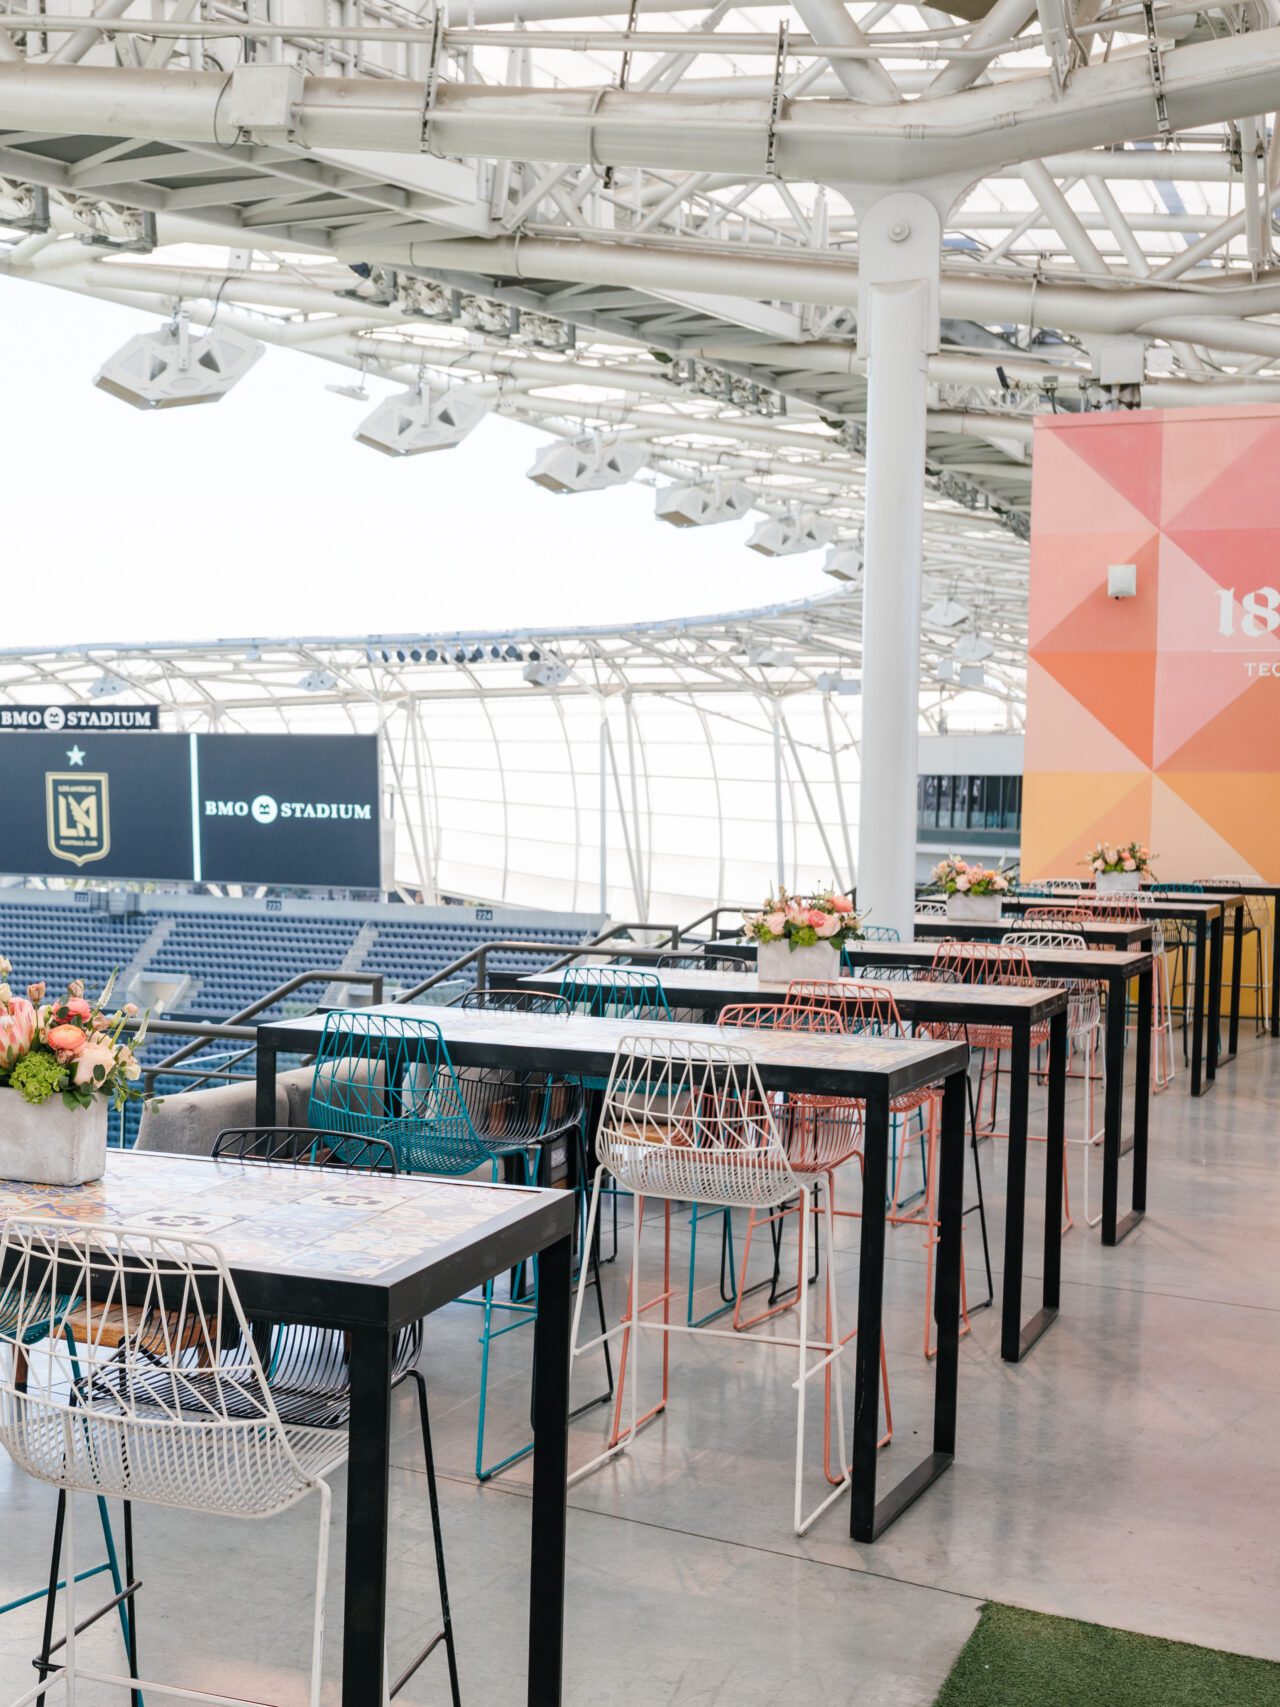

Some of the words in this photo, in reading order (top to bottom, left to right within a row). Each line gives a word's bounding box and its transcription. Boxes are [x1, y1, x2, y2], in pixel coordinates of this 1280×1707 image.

[1, 711, 42, 726] BMO
[67, 711, 151, 726] STADIUM
[205, 800, 249, 816] BMO
[280, 802, 371, 819] STADIUM
